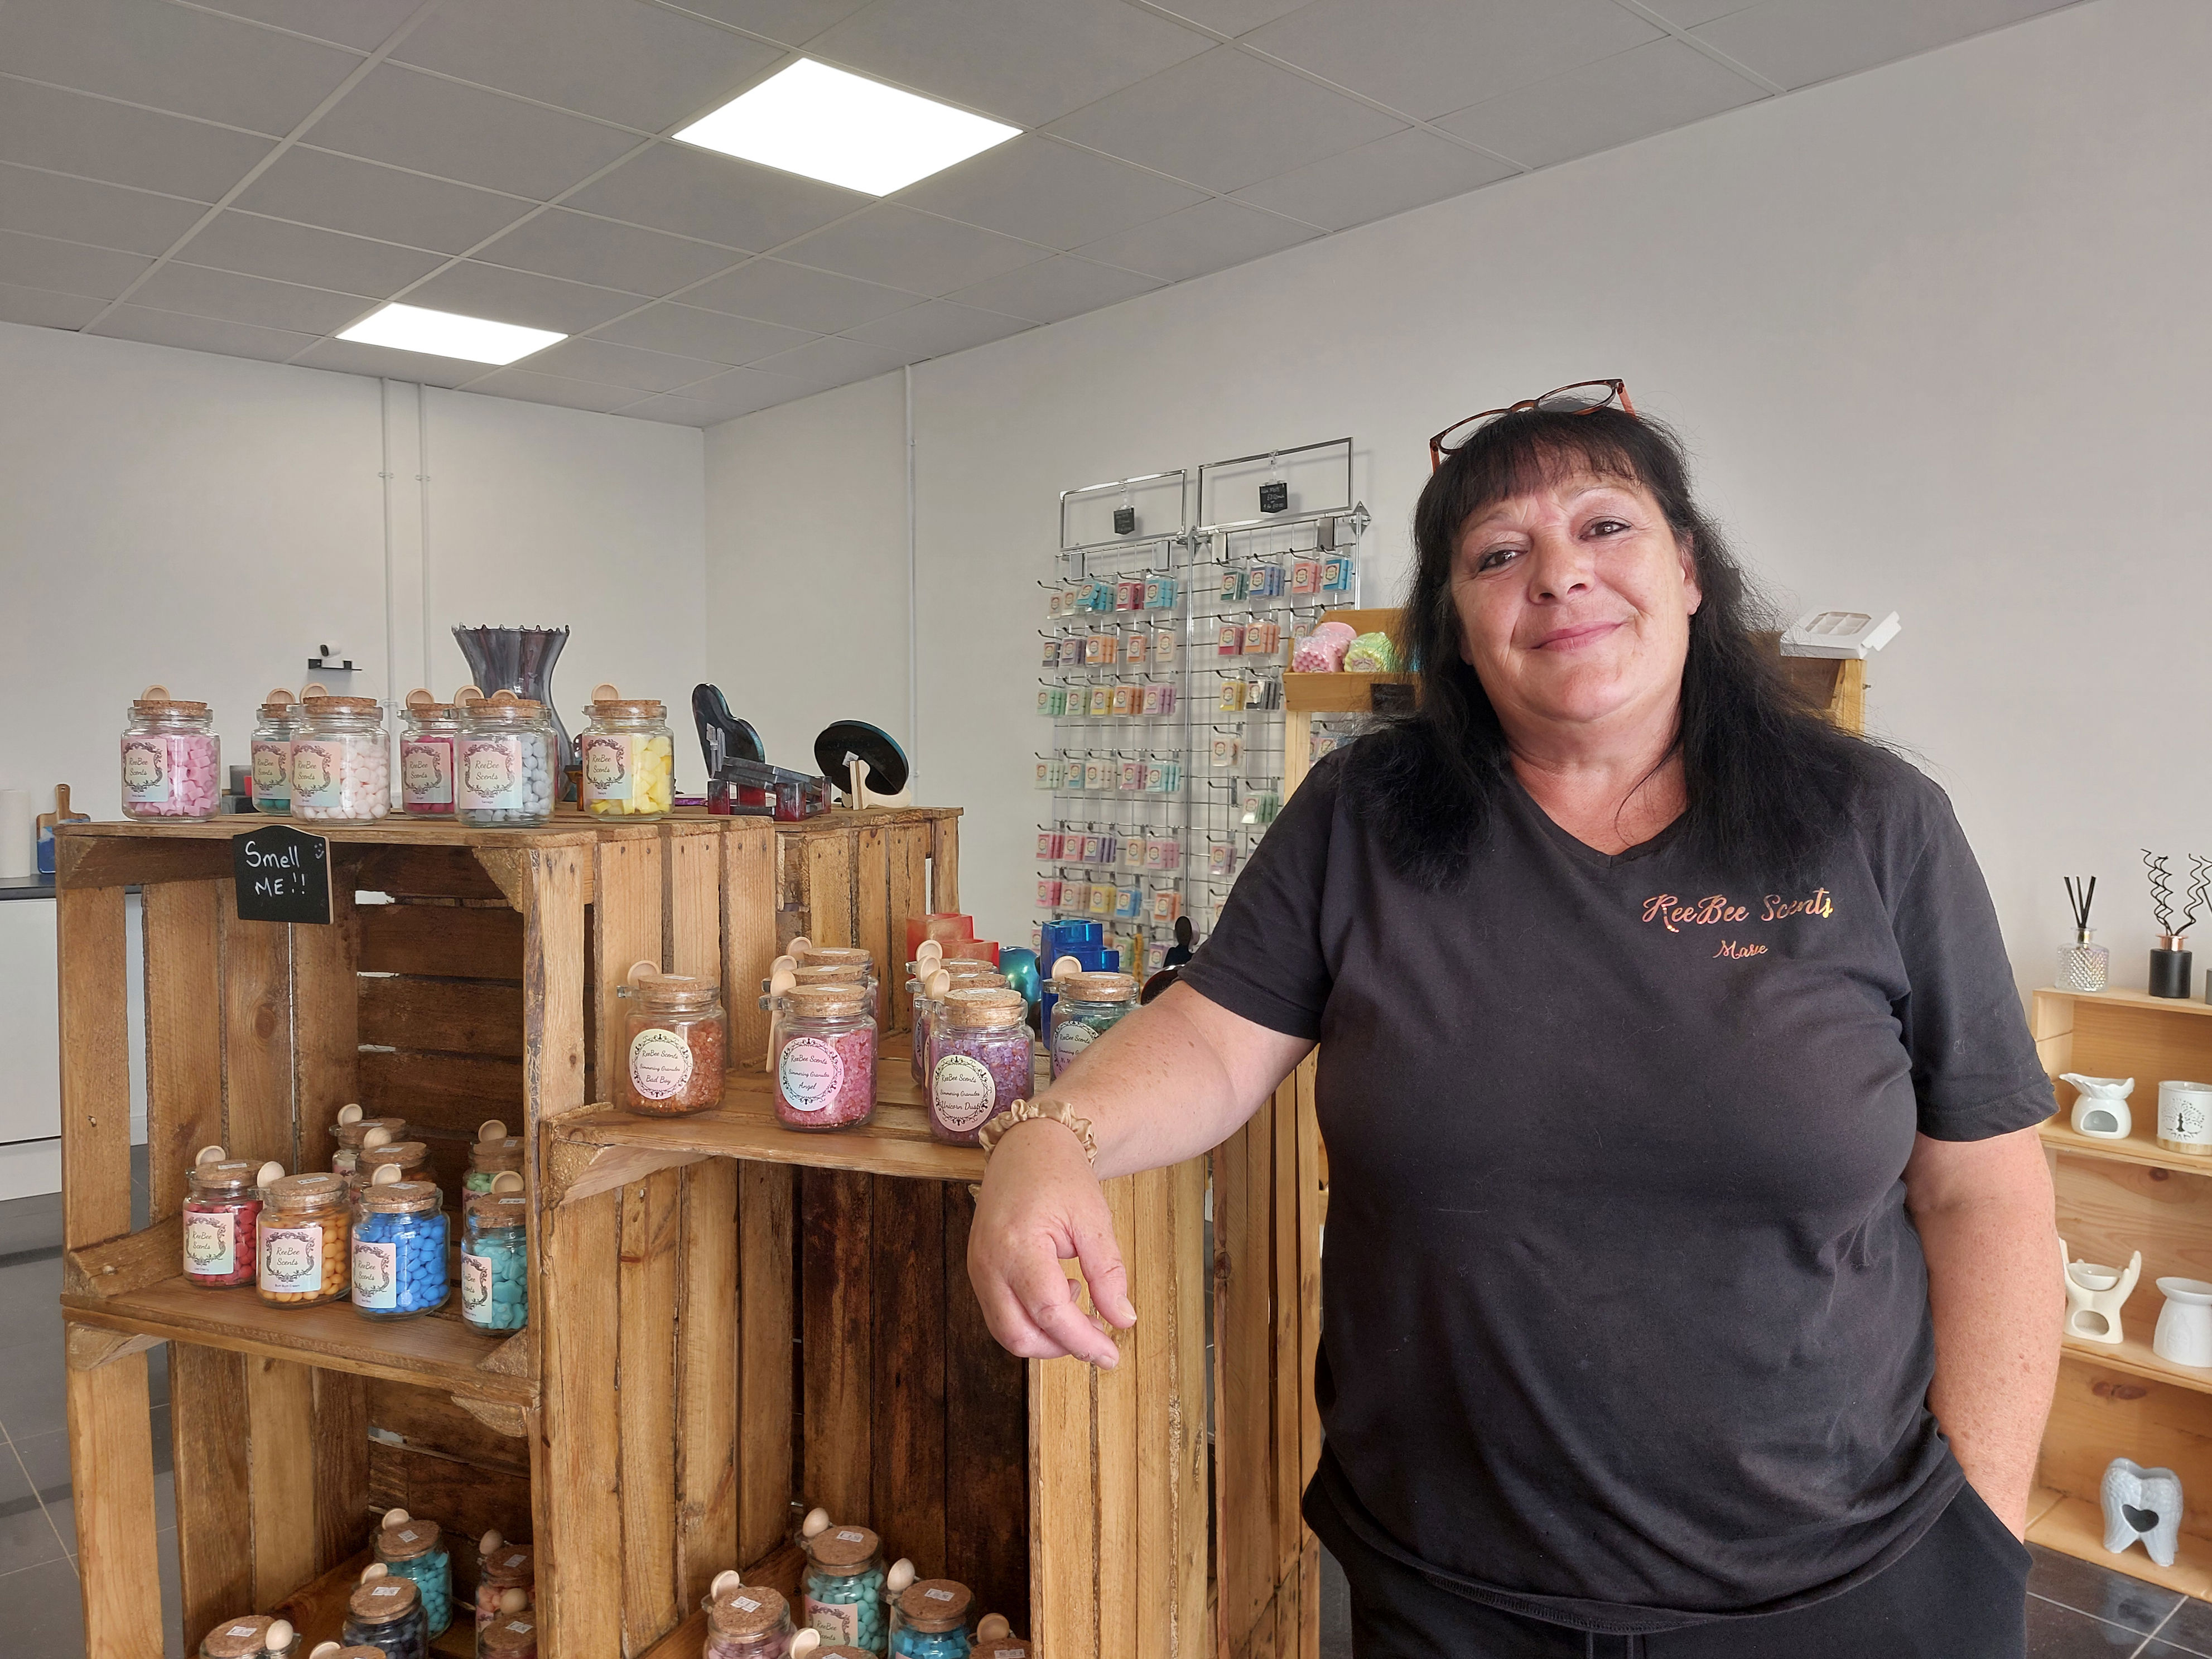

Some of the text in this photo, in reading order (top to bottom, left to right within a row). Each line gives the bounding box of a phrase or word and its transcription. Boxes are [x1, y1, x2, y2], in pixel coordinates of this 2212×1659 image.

[592, 754, 611, 763] ReeBee
[298, 760, 316, 769] ReeBee
[409, 760, 428, 769] ReeBee
[475, 760, 500, 769] ReeBee
[593, 765, 610, 773] Scents
[298, 771, 315, 780] Scents
[476, 772, 498, 780] Scents
[245, 840, 300, 869] Smell
[1642, 888, 1834, 933] ReeBee Scents
[1074, 1034, 1090, 1044] Scents
[642, 1049, 678, 1059] ReeBee Scents
[791, 1054, 827, 1064] ReeBee Scents
[788, 1068, 809, 1078] Simmering
[660, 1076, 671, 1085] Boy
[941, 1073, 976, 1083] ReeBee Scents
[798, 1082, 817, 1091] Angel
[941, 1101, 962, 1110] Unicorn
[192, 1231, 212, 1240] ReeBee
[276, 1247, 300, 1255] ReeBee
[358, 1260, 375, 1270] ReeBee
[358, 1271, 374, 1280] Scents
[817, 1620, 836, 1630] ReeBee
